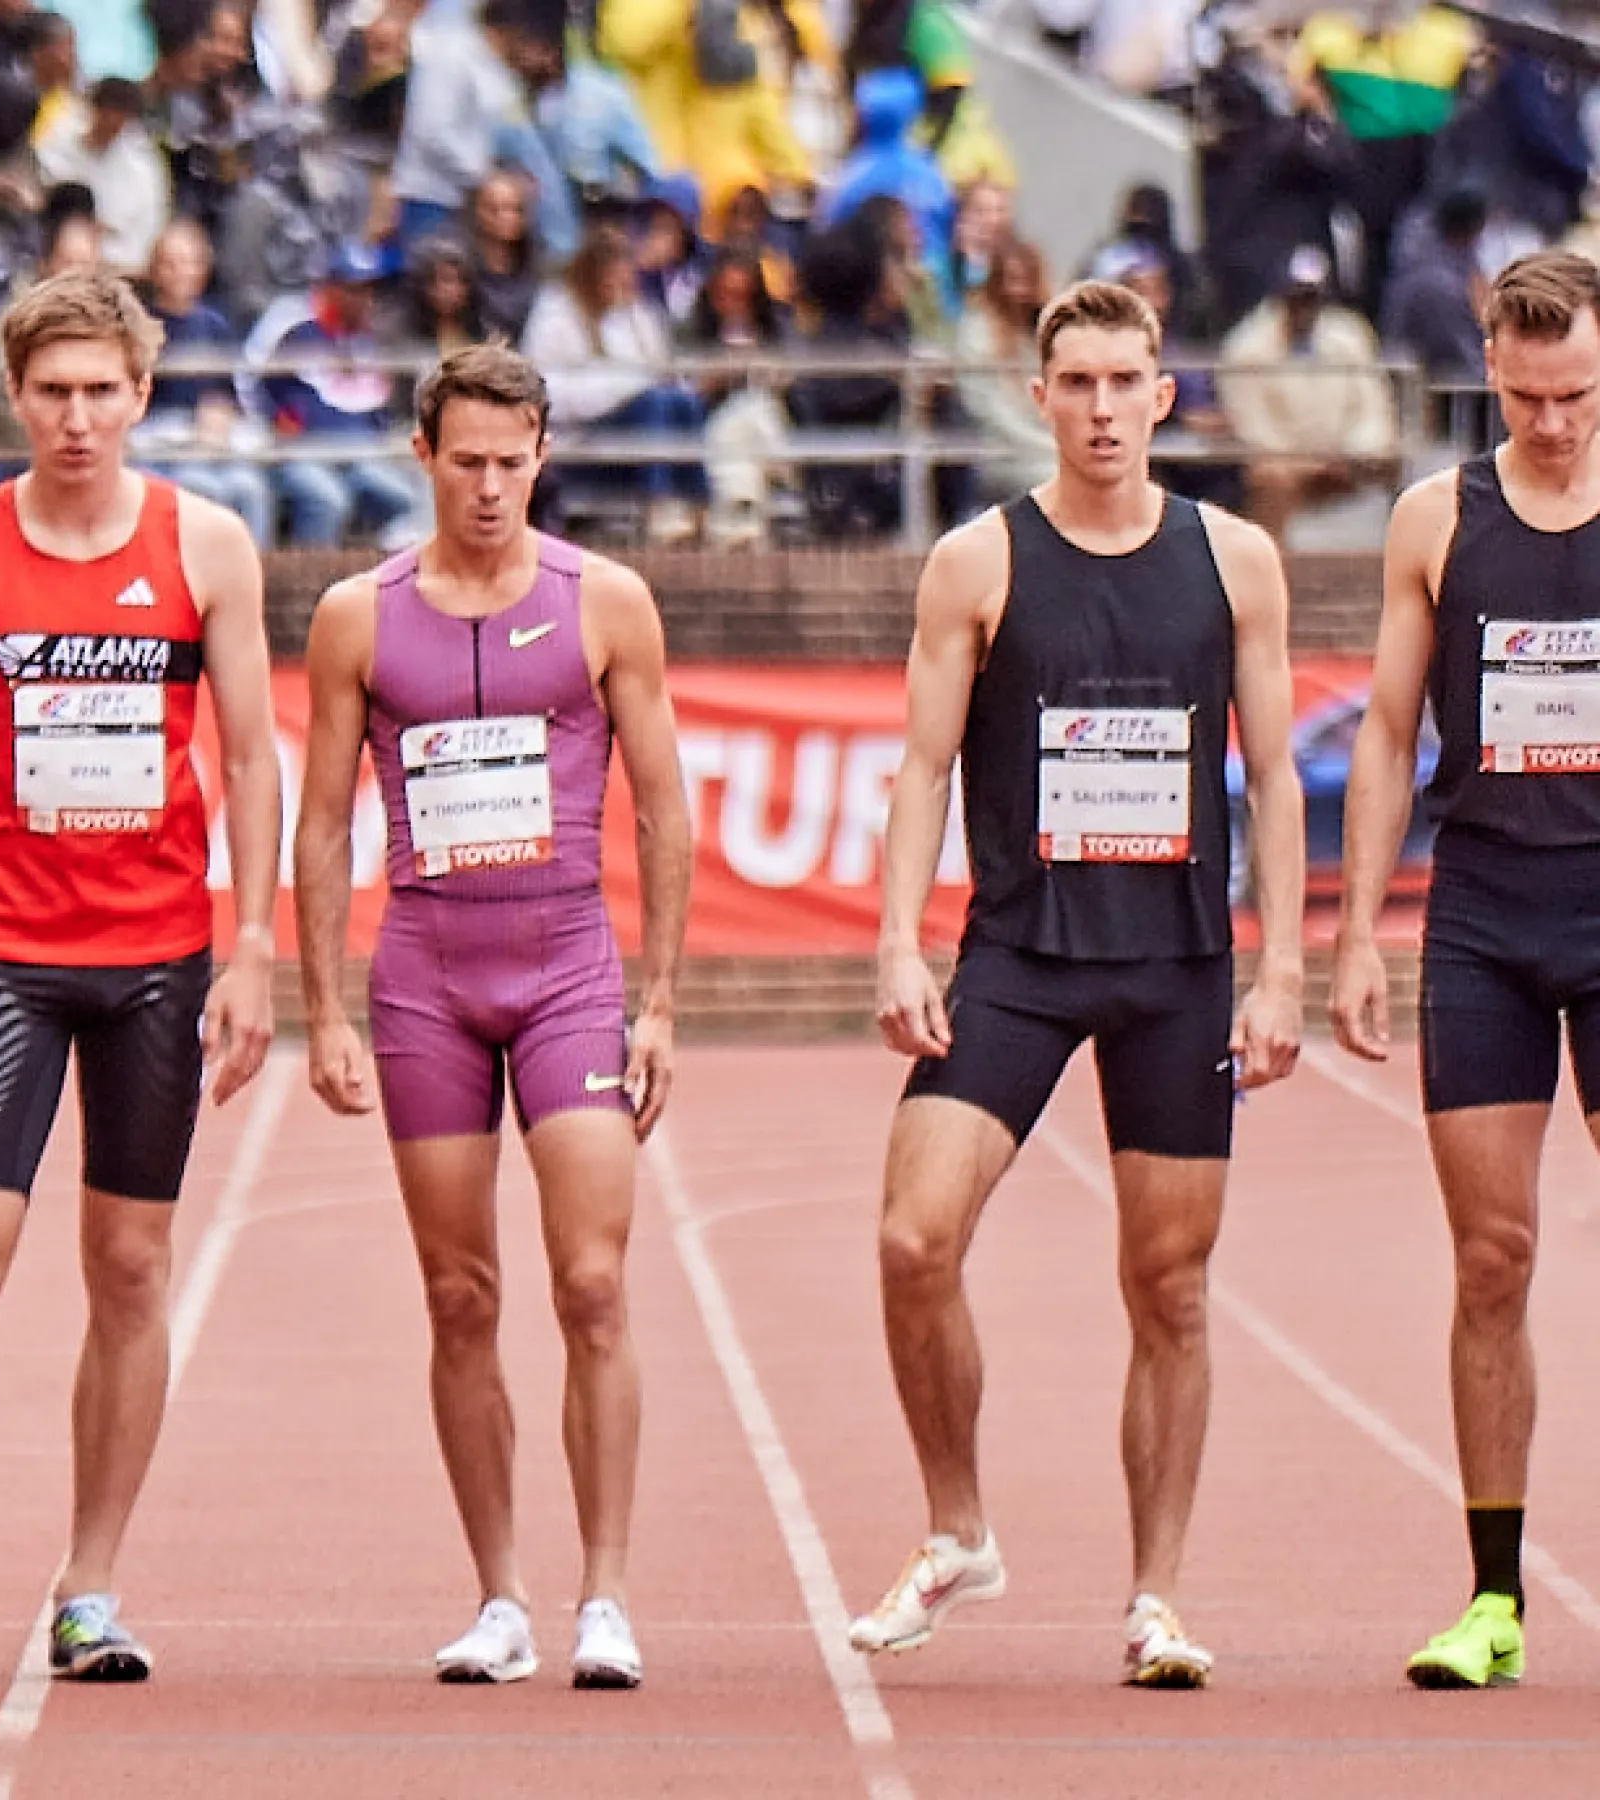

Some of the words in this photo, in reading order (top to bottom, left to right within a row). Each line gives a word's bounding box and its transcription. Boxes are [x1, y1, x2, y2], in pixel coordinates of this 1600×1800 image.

[49, 635, 171, 667] ATLANTA
[1530, 748, 1600, 768] TOYOT
[434, 797, 523, 818] THOMPSON
[1072, 790, 1159, 804] SALISBURY
[61, 811, 149, 831] TOYOTA
[453, 842, 538, 867] TOYOTA
[1085, 836, 1174, 857] TOYOTA
